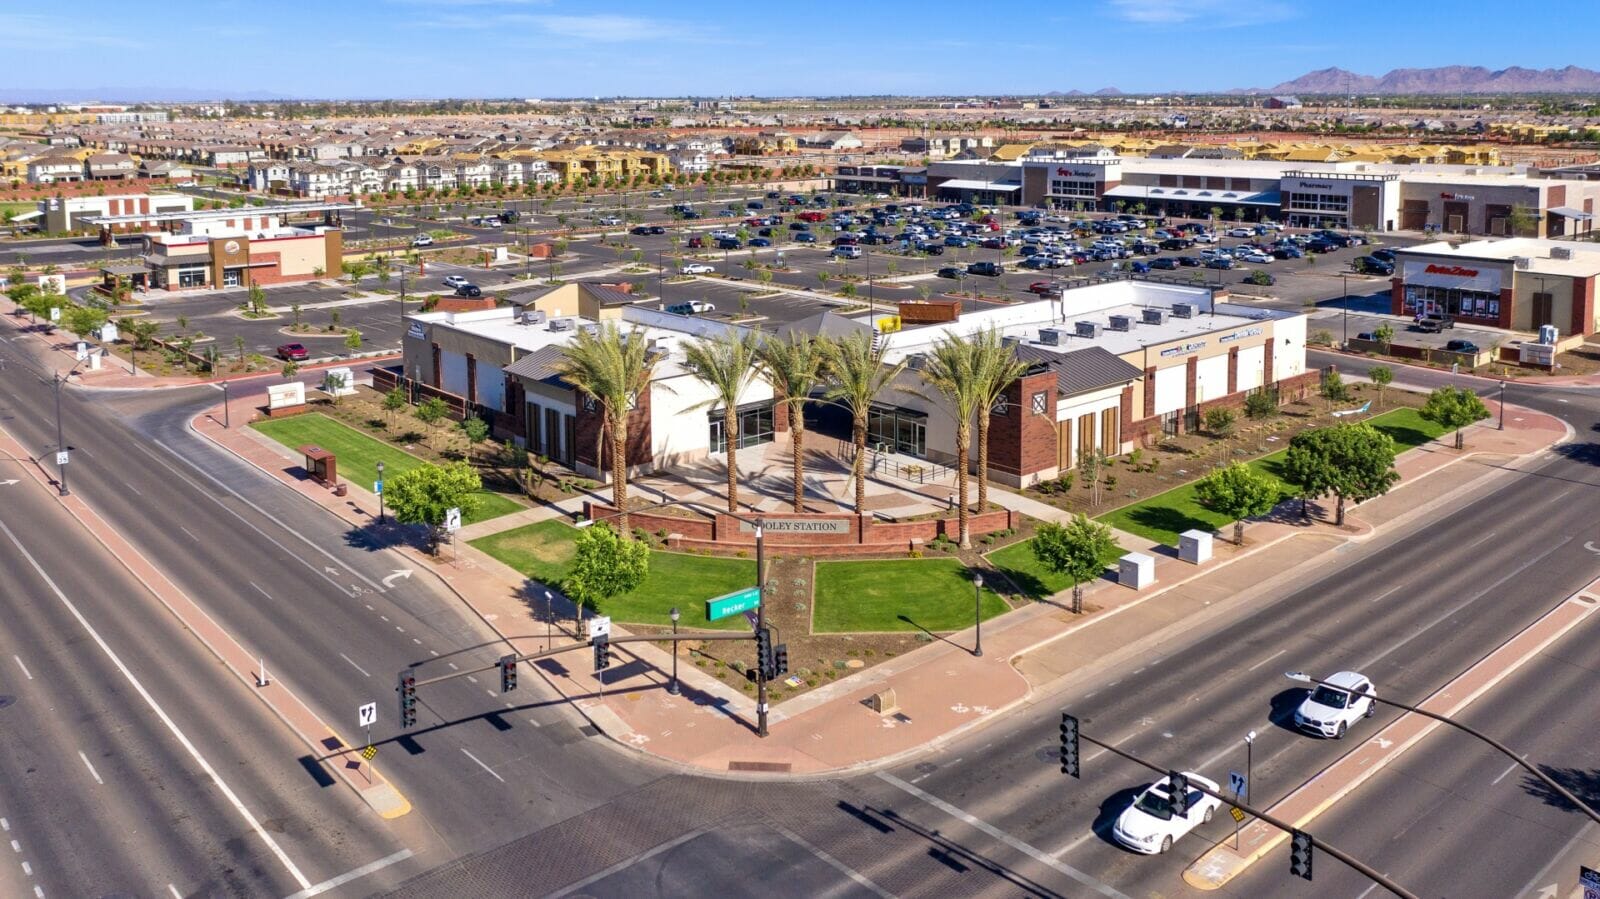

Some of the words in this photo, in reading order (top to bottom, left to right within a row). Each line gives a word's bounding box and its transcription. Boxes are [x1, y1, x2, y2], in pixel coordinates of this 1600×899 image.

[1300, 181, 1333, 190] Pharmacy
[1425, 264, 1478, 277] AutoZone
[793, 522, 837, 531] STATION
